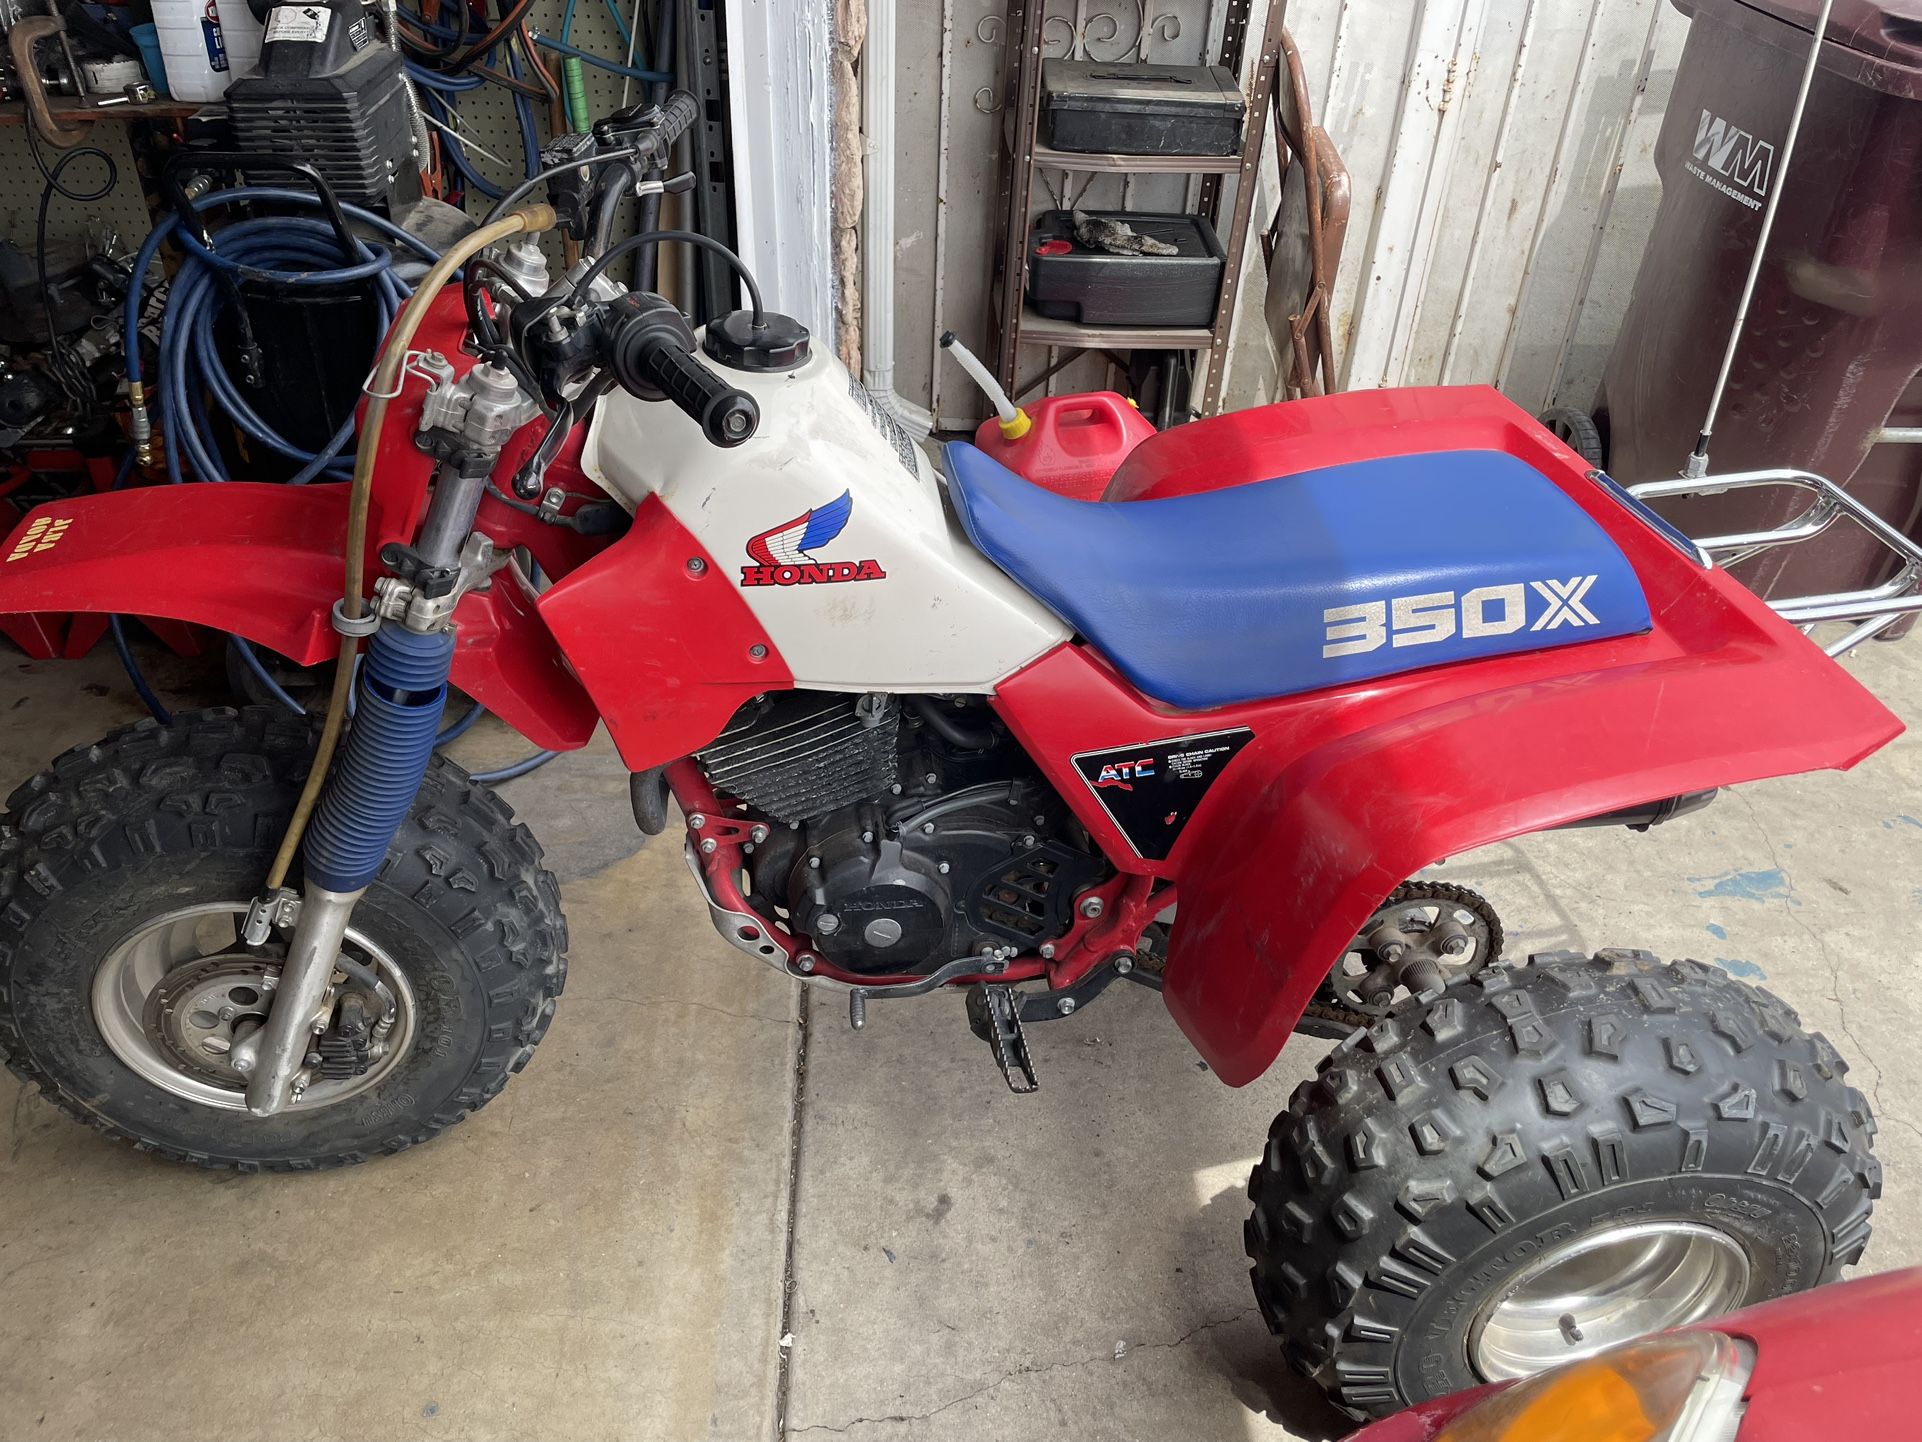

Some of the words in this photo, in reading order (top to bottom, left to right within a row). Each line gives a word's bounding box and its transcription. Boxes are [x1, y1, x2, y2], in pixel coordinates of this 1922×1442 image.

[1693, 108, 1775, 196] WM
[1684, 161, 1704, 180] WASTE
[1704, 175, 1762, 211] MANAGEMENT
[740, 559, 887, 587] HONDA
[1322, 574, 1601, 659] 350X
[1098, 758, 1156, 783] ATC
[843, 900, 924, 912] HONDA
